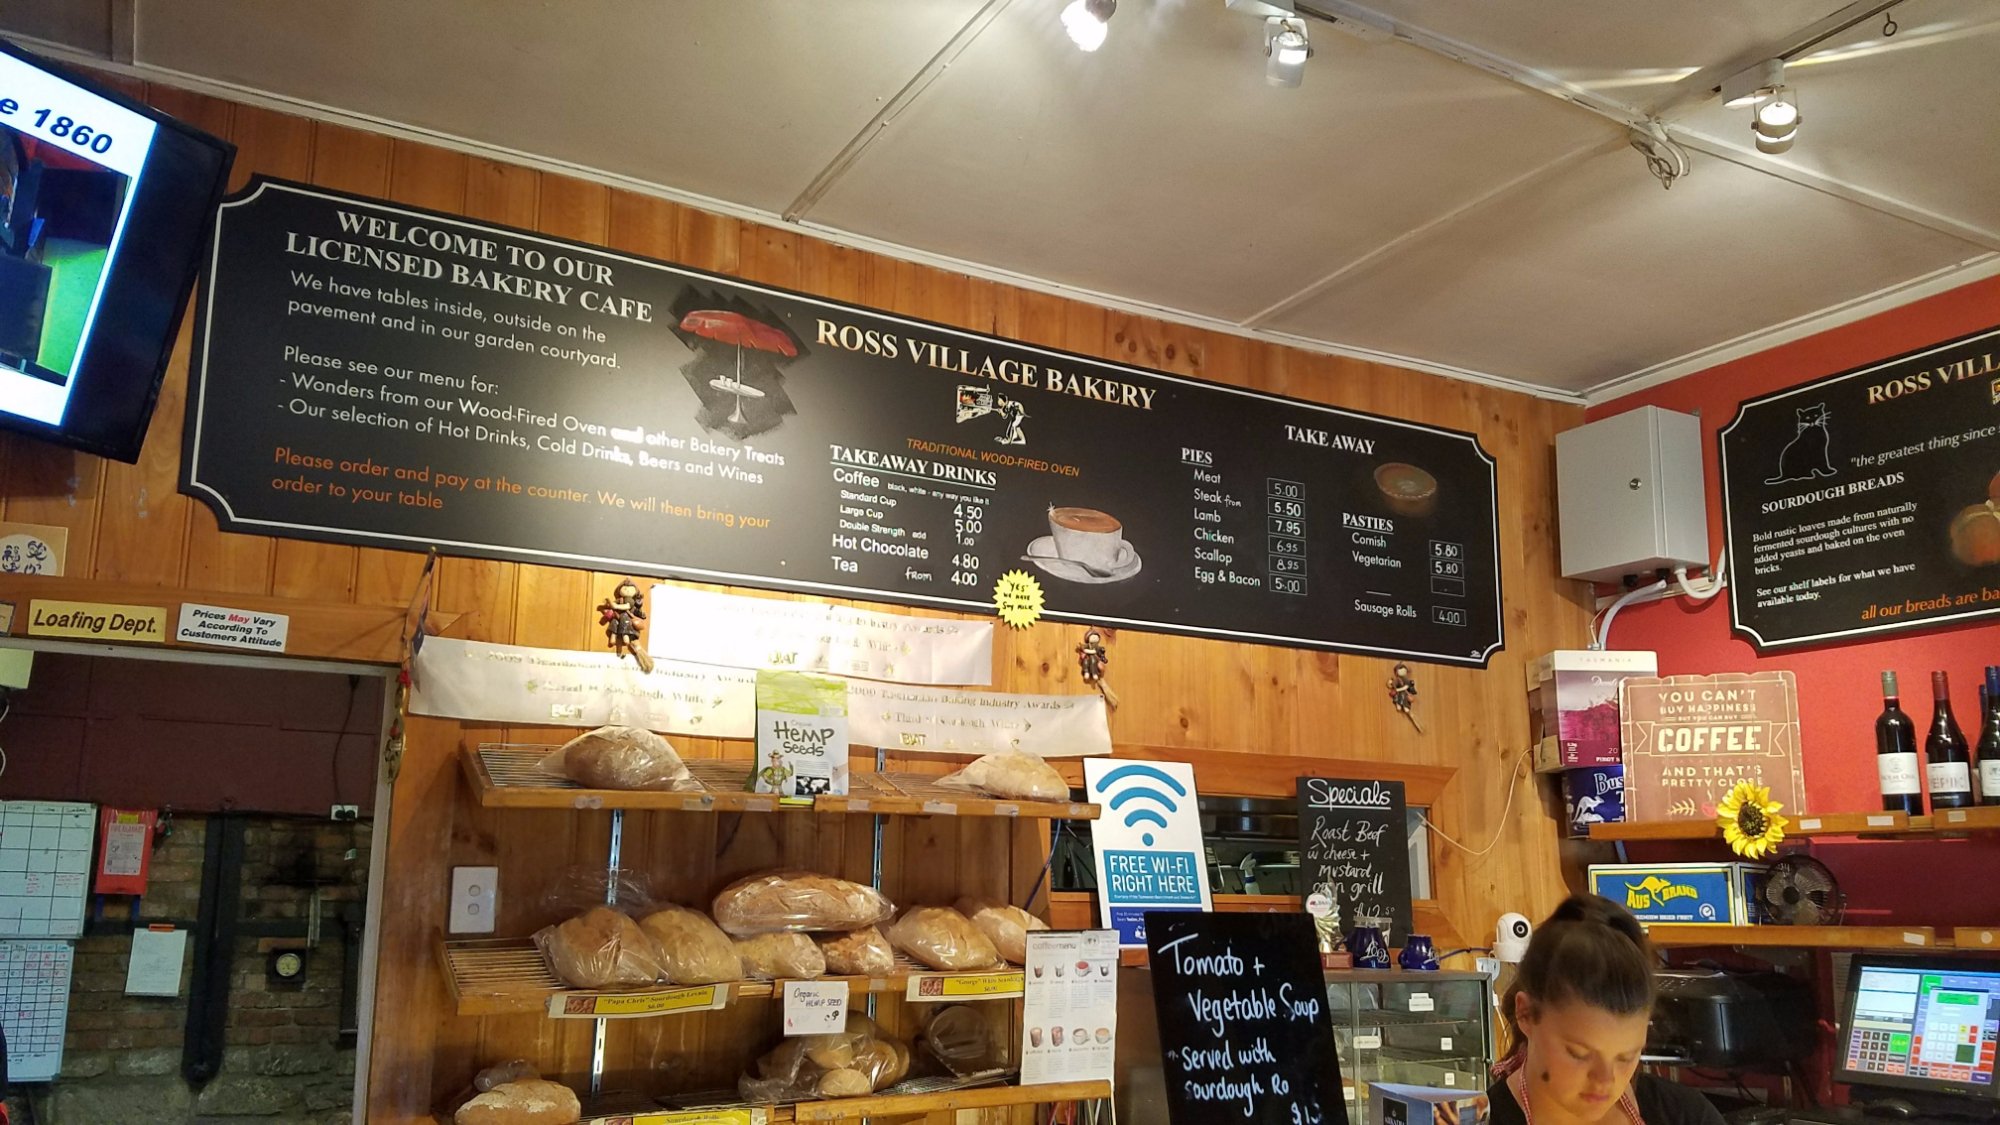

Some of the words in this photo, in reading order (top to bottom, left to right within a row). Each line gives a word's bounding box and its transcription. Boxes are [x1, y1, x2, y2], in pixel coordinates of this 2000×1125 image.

[34, 109, 112, 154] 1860
[336, 210, 498, 262] WELCOME
[506, 246, 546, 271] TO
[553, 256, 614, 287] OUR
[285, 231, 442, 280] LICENSED
[451, 264, 573, 305] BAKERY
[579, 290, 653, 323] CAFE
[291, 270, 323, 290] We
[329, 276, 371, 301] have
[377, 286, 429, 310] tables
[434, 298, 487, 322] inside,
[494, 308, 551, 333] outside
[557, 322, 576, 337] on
[582, 325, 606, 343] the
[816, 319, 899, 359] ROSS
[905, 337, 1038, 388] VILLAGE
[1046, 368, 1157, 410] BAKERY
[1868, 372, 1931, 404] ROSS
[1285, 425, 1328, 447] TAKE
[1332, 434, 1375, 454] AWAY
[1878, 443, 1925, 466] greatest
[1928, 430, 1960, 450] thing
[1962, 426, 1995, 442] since
[830, 445, 928, 475] TAKEAWAY
[932, 462, 997, 485] DRINKS
[907, 438, 977, 460] TRADITIONAL
[980, 451, 1048, 472] WOOD-FIRED
[1051, 464, 1080, 476] OVEN
[1181, 448, 1212, 464] PIES
[833, 468, 880, 487] Coffee
[1194, 469, 1220, 484] Meat
[1274, 483, 1298, 498] 5.00
[840, 490, 877, 504] Standard
[879, 495, 897, 507] Cup
[953, 504, 982, 520] 4.50
[1194, 488, 1222, 504] Steak
[1224, 494, 1242, 508] from
[1274, 502, 1301, 517] 5.50
[1761, 485, 1845, 513] SOURDOUGH
[1848, 472, 1905, 494] BREADS
[840, 505, 864, 517] Large
[866, 508, 883, 520] Cup
[954, 519, 982, 534] 5.00
[840, 520, 869, 532] Double
[871, 524, 905, 537] Strength
[912, 531, 926, 539] add
[956, 532, 974, 546] 1.00
[1194, 508, 1221, 523] Lamb
[1275, 520, 1301, 535] 7.95
[1342, 513, 1394, 532] PASTIES
[1753, 530, 1772, 542] Bold
[1774, 526, 1797, 538] rustic
[1799, 519, 1826, 532] loaves
[1828, 516, 1851, 528] made
[1853, 510, 1875, 522] from
[1877, 501, 1917, 518] naturally
[1194, 528, 1234, 544] Chicken
[1276, 540, 1298, 553] 6.95
[1352, 532, 1386, 548] Cornish
[1435, 544, 1458, 557] 5.80
[1754, 538, 1794, 553] fermented
[1796, 528, 1840, 546] sourdough
[1842, 521, 1877, 535] cultures
[1879, 517, 1899, 528] with
[1902, 516, 1914, 524] no
[1754, 552, 1778, 564] added
[1780, 548, 1805, 560] yeasts
[1807, 544, 1823, 554] and
[1825, 538, 1850, 550] baked
[1852, 537, 1864, 545] on
[1866, 533, 1880, 543] the
[1882, 529, 1905, 540] oven
[832, 534, 857, 550] Hot
[860, 539, 929, 559] Chocolate
[952, 553, 979, 569] 4.80
[1194, 548, 1232, 564] Scallop
[1277, 559, 1299, 571] 8.95
[1352, 551, 1401, 569] Vegetarian
[1435, 562, 1458, 574] 5.80
[832, 556, 858, 572] Tea
[951, 571, 978, 585] 4.00
[1194, 567, 1214, 583] Egg
[1218, 571, 1226, 582] &
[1229, 571, 1260, 586] Bacon
[1275, 577, 1300, 592] 5.00
[1755, 564, 1781, 575] bricks.
[1756, 586, 1771, 597] See
[1773, 585, 1787, 594] our
[1789, 580, 1809, 591] shelf
[1811, 576, 1836, 587] labels
[1838, 573, 1851, 583] for
[1853, 569, 1876, 580] what
[1878, 568, 1891, 576] we
[1893, 562, 1915, 573] have
[1354, 600, 1394, 617] Sausage
[1396, 604, 1417, 618] Rolls
[1438, 612, 1460, 624] 4.00
[1757, 594, 1794, 608] available
[1796, 590, 1821, 602] today.
[1862, 605, 1876, 620] all
[1880, 605, 1901, 617] our
[1906, 597, 1951, 613] breads
[1955, 591, 1978, 605] are
[34, 609, 105, 632] Loafing
[109, 614, 157, 635] Dept.
[192, 610, 225, 620] Prices
[228, 613, 249, 624] May
[252, 616, 276, 627] Vary
[198, 620, 253, 635] According
[255, 627, 268, 635] To
[181, 628, 237, 642] Customers
[240, 633, 282, 647] Attitude
[1659, 691, 1694, 702] YOU
[1701, 690, 1756, 701] CAN'T
[1660, 705, 1684, 714] BUY
[1688, 704, 1756, 714] HAPPINESS
[1658, 726, 1761, 752] COFFEE
[1662, 767, 1696, 776] AND
[1703, 765, 1762, 776] THAT'S
[1662, 779, 1712, 787] PRETTY
[1718, 777, 1763, 786] CLOSE
[1307, 779, 1391, 811] Specials
[1311, 815, 1350, 848] Roast
[1356, 821, 1388, 846] Beef
[1110, 855, 1147, 873] FREE
[1151, 856, 1189, 873] WI-FI
[1324, 843, 1357, 860] cheese
[1319, 861, 1372, 877] mustard
[1112, 875, 1152, 892] RIGHT
[1158, 876, 1195, 893] HERE
[1350, 872, 1384, 901] grill
[1626, 889, 1650, 908] AUS
[1662, 886, 1698, 901] BRAND
[1158, 933, 1244, 976] Tomato
[1188, 988, 1276, 1038] Vegetable
[1279, 983, 1318, 1024] Soup
[1239, 1037, 1276, 1064] with
[1184, 1075, 1264, 1117] sourdough
